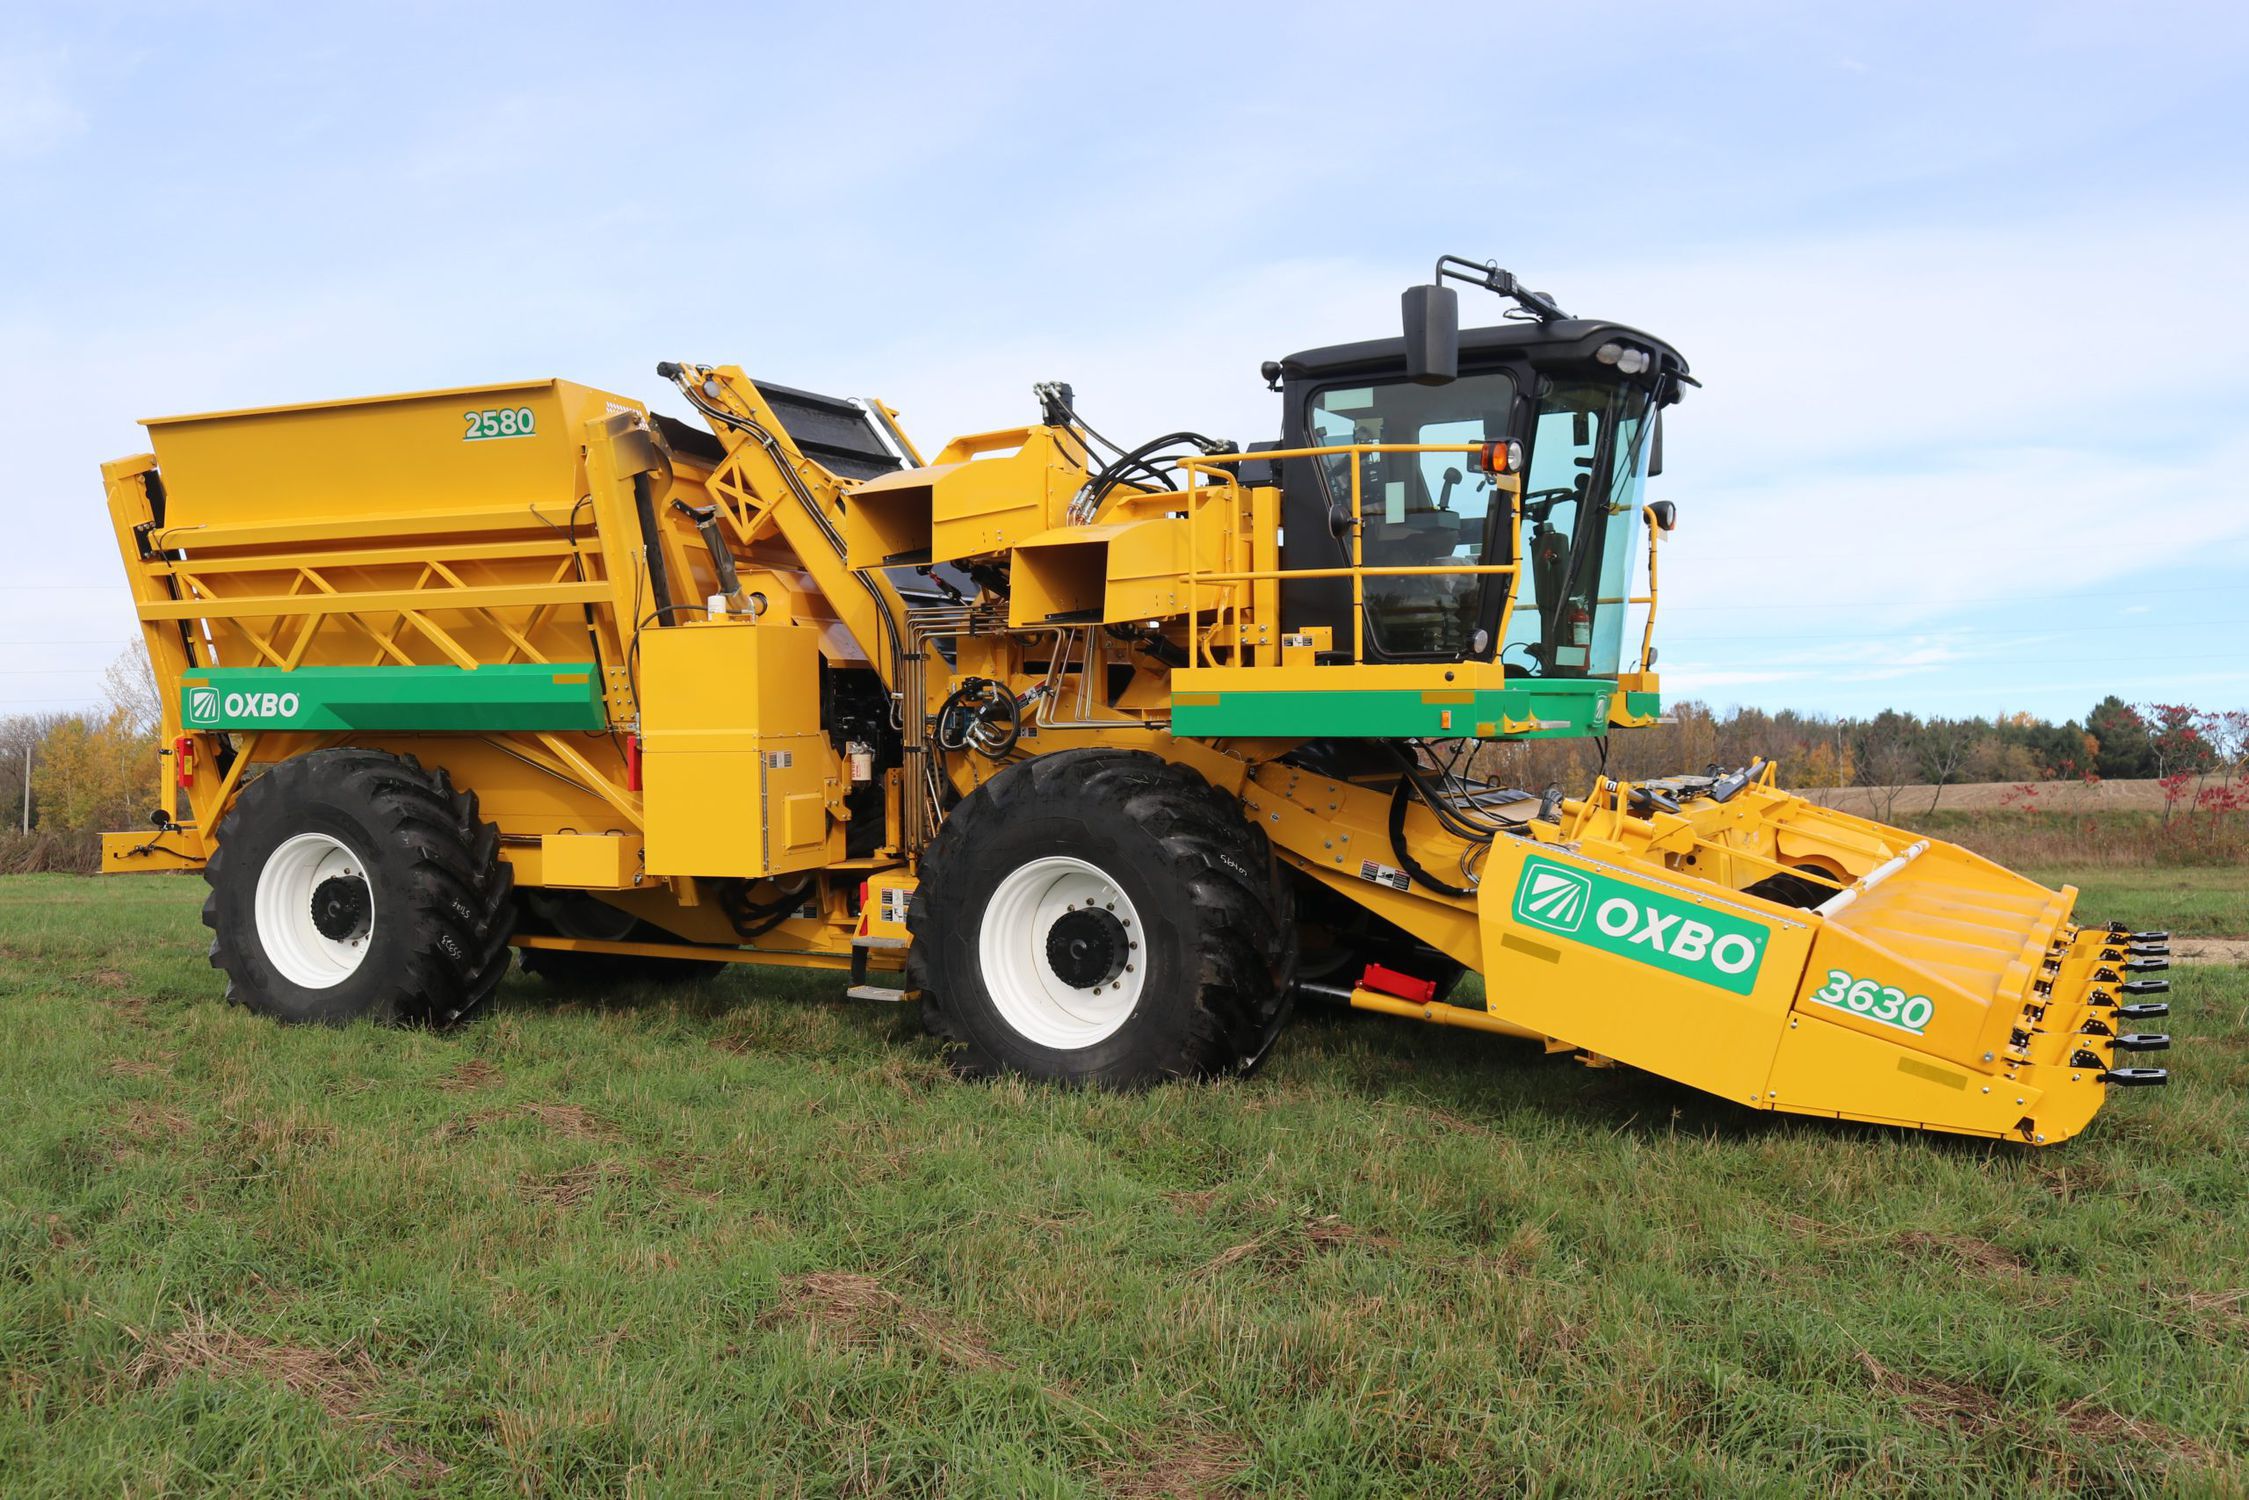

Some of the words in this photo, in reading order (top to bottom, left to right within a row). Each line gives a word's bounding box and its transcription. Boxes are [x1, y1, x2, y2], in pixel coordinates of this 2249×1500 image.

[465, 408, 535, 437] 2580
[224, 692, 300, 718] OXBO
[1595, 897, 1757, 974] OXBO
[1818, 970, 1934, 1029] 3630
